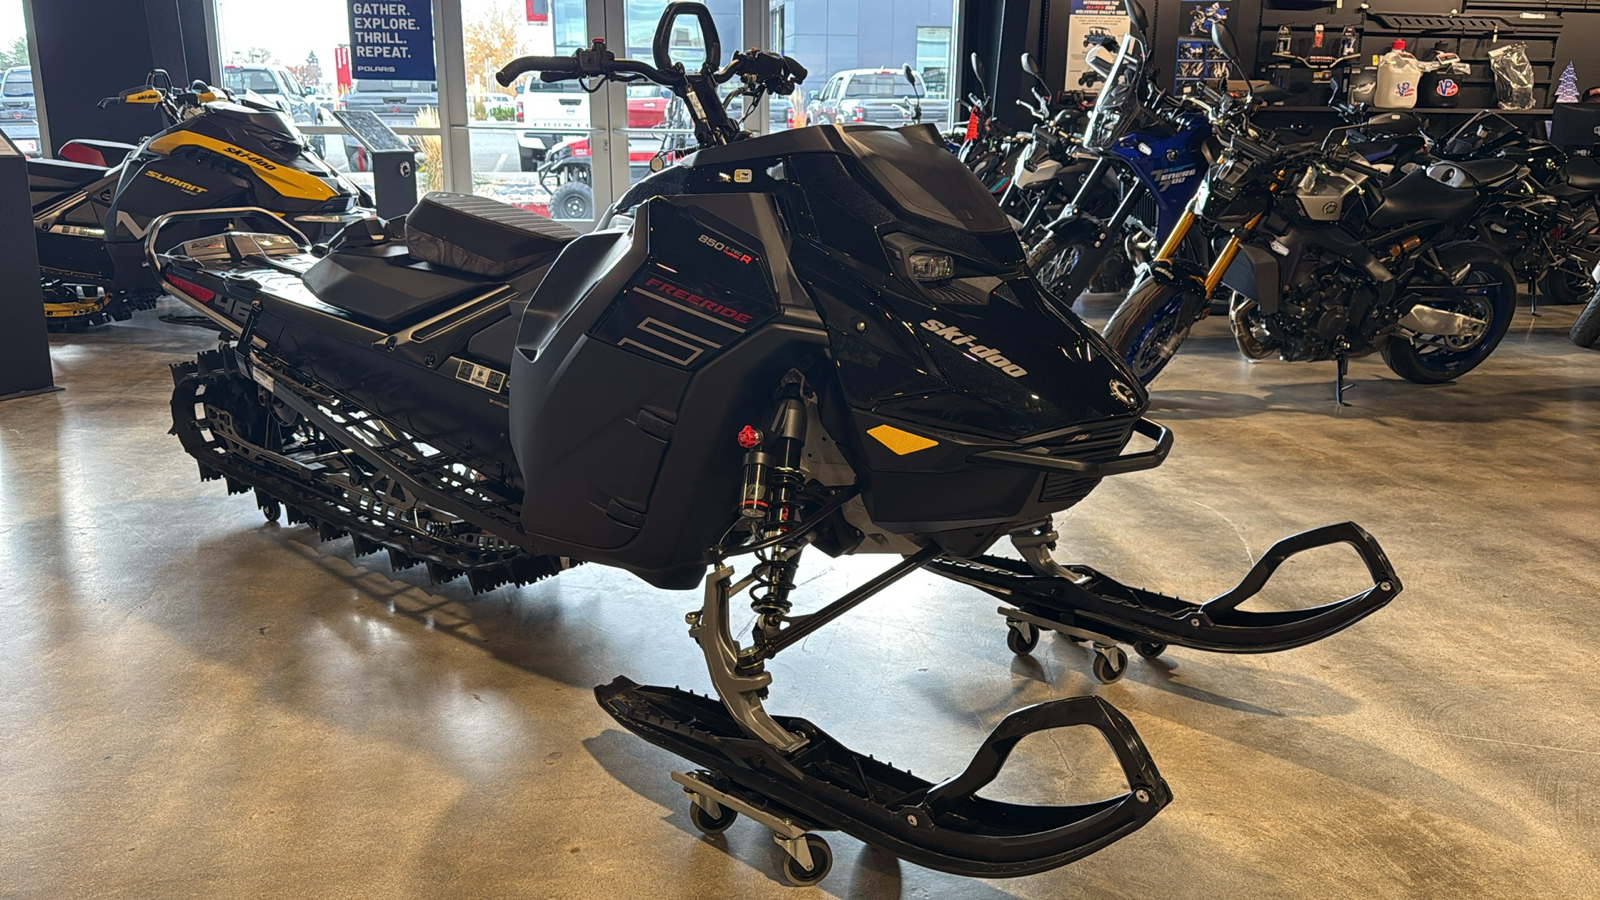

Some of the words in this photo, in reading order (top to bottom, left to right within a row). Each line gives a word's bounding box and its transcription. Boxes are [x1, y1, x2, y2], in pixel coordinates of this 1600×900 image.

[353, 3, 410, 16] GATHER.
[354, 18, 420, 30] EXPLORE.
[355, 32, 407, 44] THRILL.
[356, 46, 411, 58] REPEAT.
[223, 147, 277, 172] ski-doo
[145, 170, 208, 193] SUMMIT
[698, 234, 726, 251] 850
[739, 254, 752, 265] R
[645, 278, 754, 325] FREERIDE
[920, 319, 1028, 378] ski-doo
